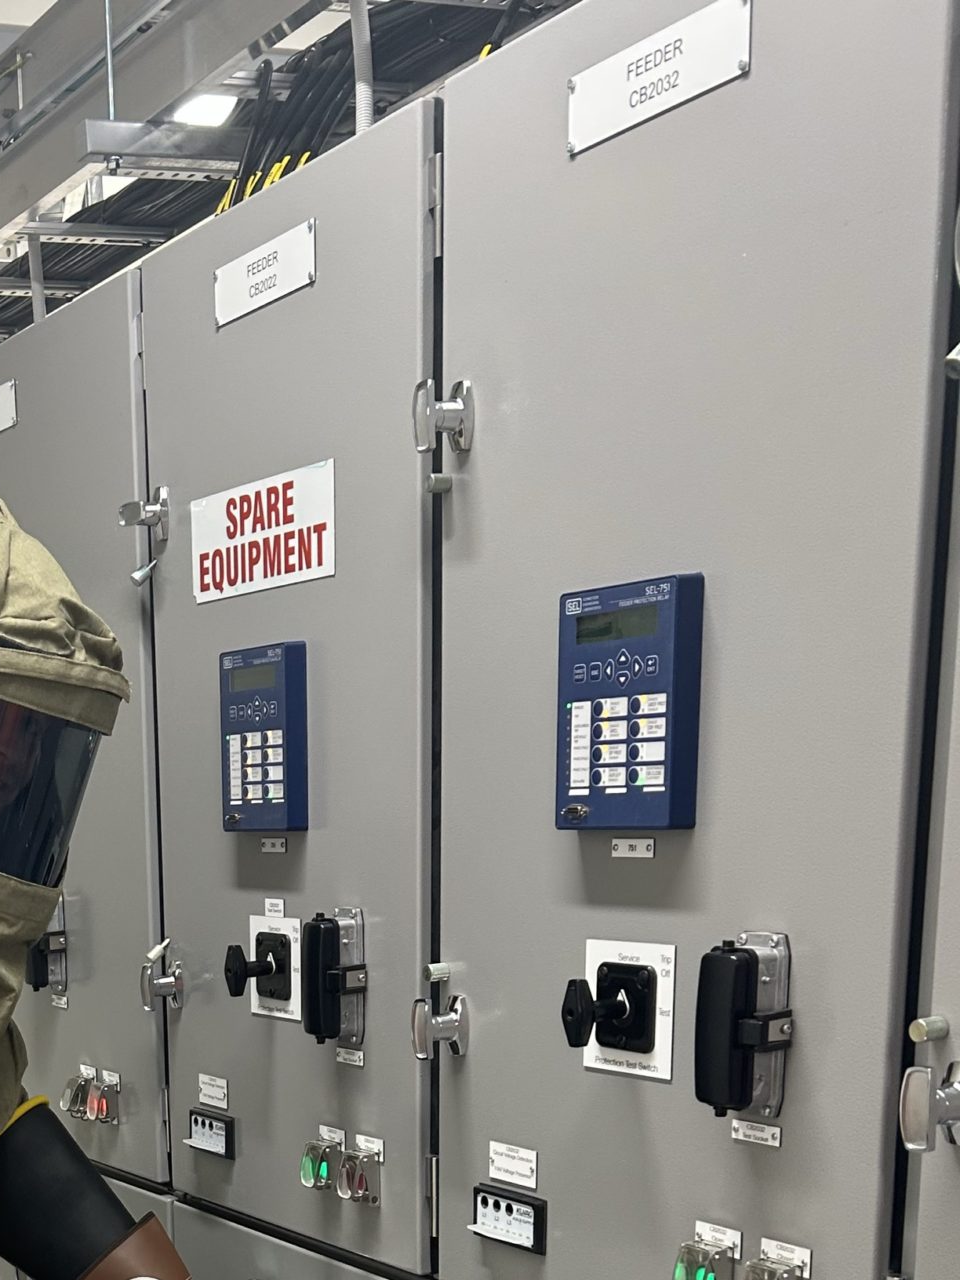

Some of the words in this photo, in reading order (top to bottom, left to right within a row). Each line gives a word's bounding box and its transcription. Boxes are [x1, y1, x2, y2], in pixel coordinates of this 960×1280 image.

[626, 38, 684, 81] FEEDER
[629, 70, 680, 108] CB2032
[247, 251, 279, 277] FEEDER
[249, 274, 277, 298] CB2022
[226, 480, 294, 540] SPARE
[199, 522, 327, 594] EQUIPMENT
[567, 601, 580, 611] SEL
[618, 953, 640, 962] Service
[660, 954, 672, 964] Trip
[594, 1056, 624, 1068] Protection
[626, 1060, 637, 1069] Test
[638, 1062, 658, 1072] Switch
